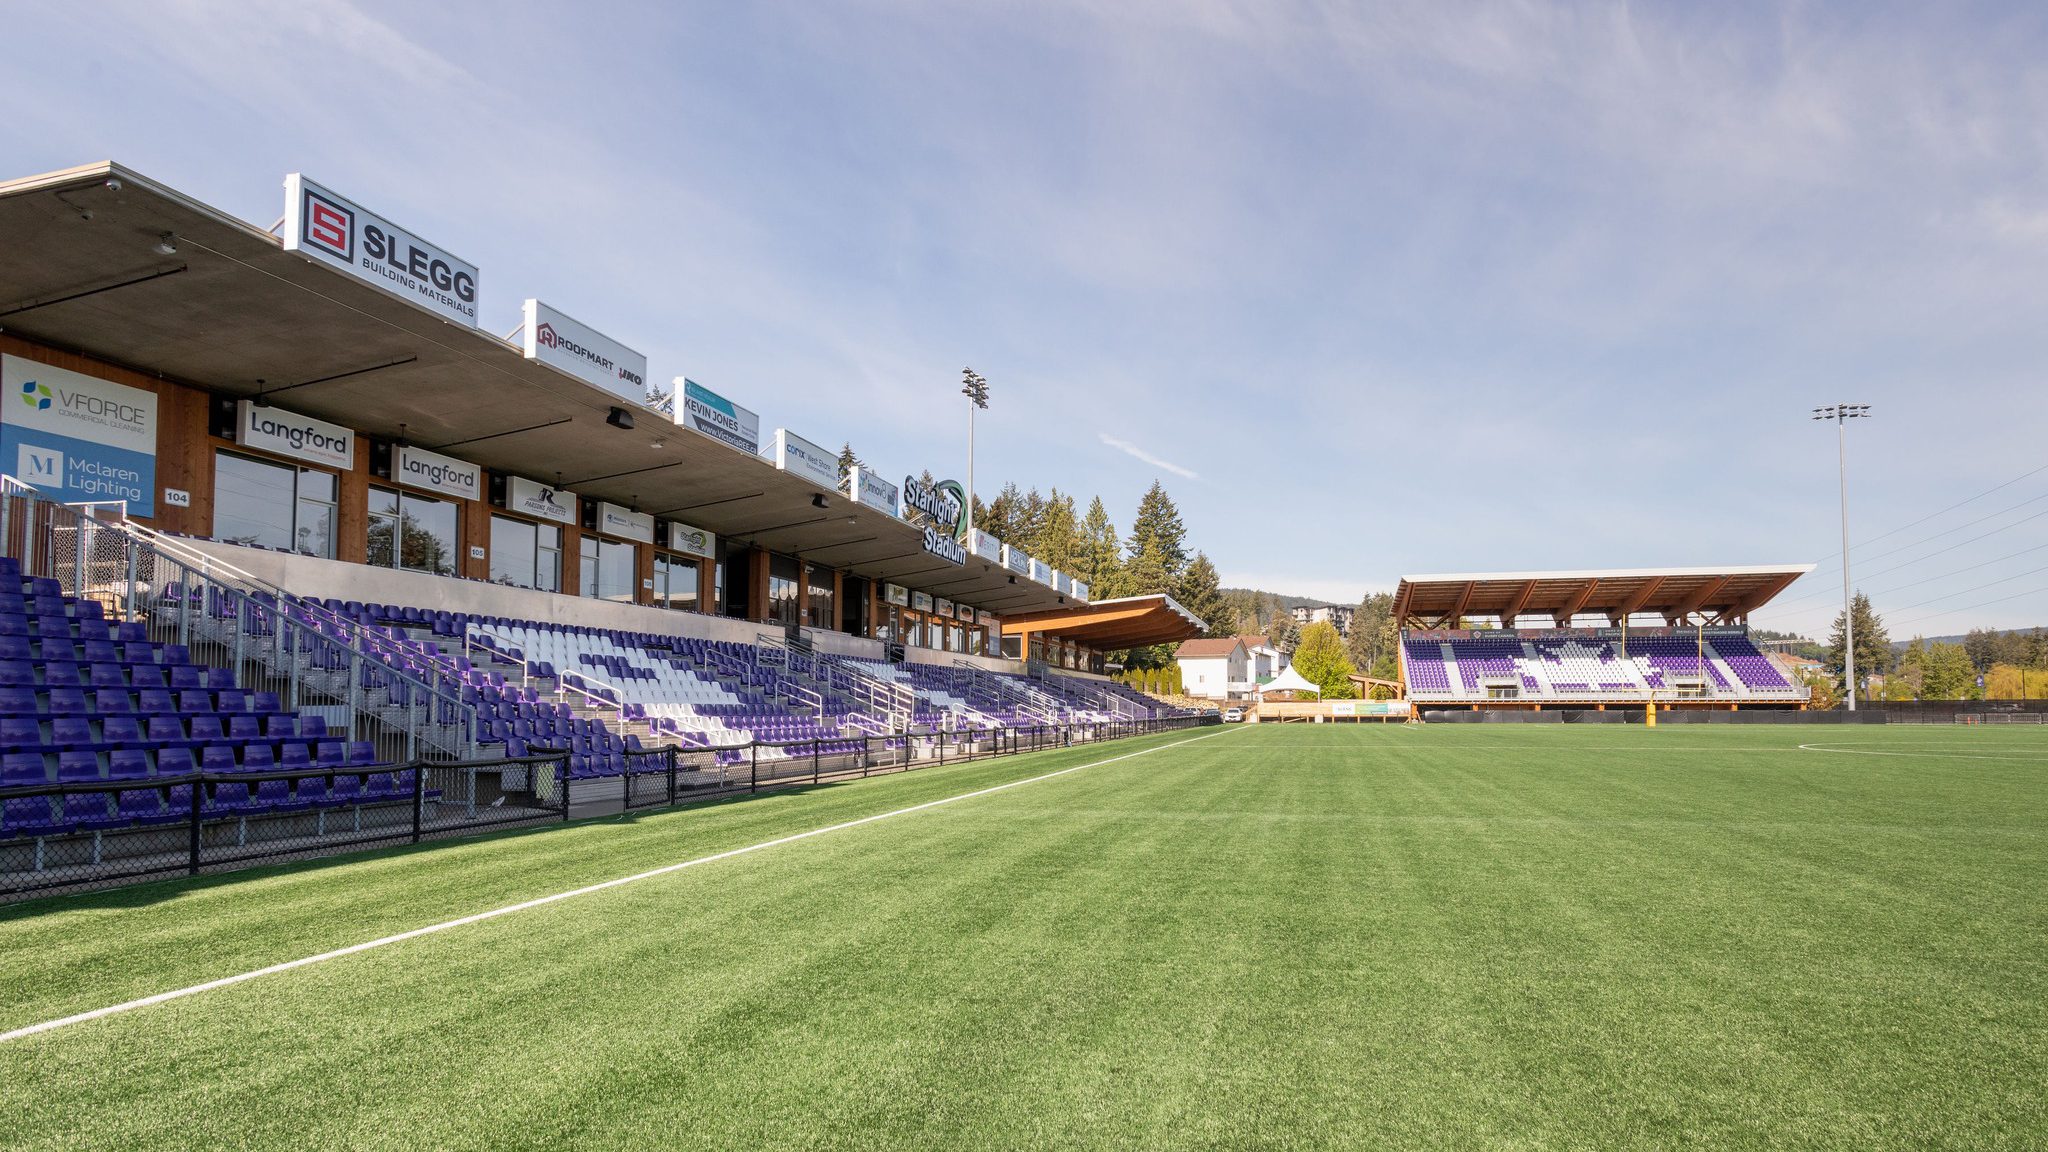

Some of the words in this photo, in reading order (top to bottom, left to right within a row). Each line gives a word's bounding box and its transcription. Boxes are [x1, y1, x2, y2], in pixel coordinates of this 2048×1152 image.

[363, 224, 474, 302] SLEGG
[363, 258, 415, 289] BUILDING
[418, 284, 474, 317] MATERIALS
[558, 335, 614, 371] ROOFMART
[58, 409, 108, 426] COMMERCIAL
[110, 420, 145, 435] CLEANING
[59, 389, 145, 425] VFORCE
[685, 397, 711, 419] KEVIN
[712, 411, 739, 432] JONES
[252, 412, 347, 450] Langford
[29, 454, 54, 476] M
[69, 456, 139, 482] Mclaren
[403, 453, 474, 487] Langford
[69, 474, 141, 501] Lighting
[167, 492, 188, 503] 104
[906, 479, 957, 527] Starlight
[923, 526, 967, 565] Stadium
